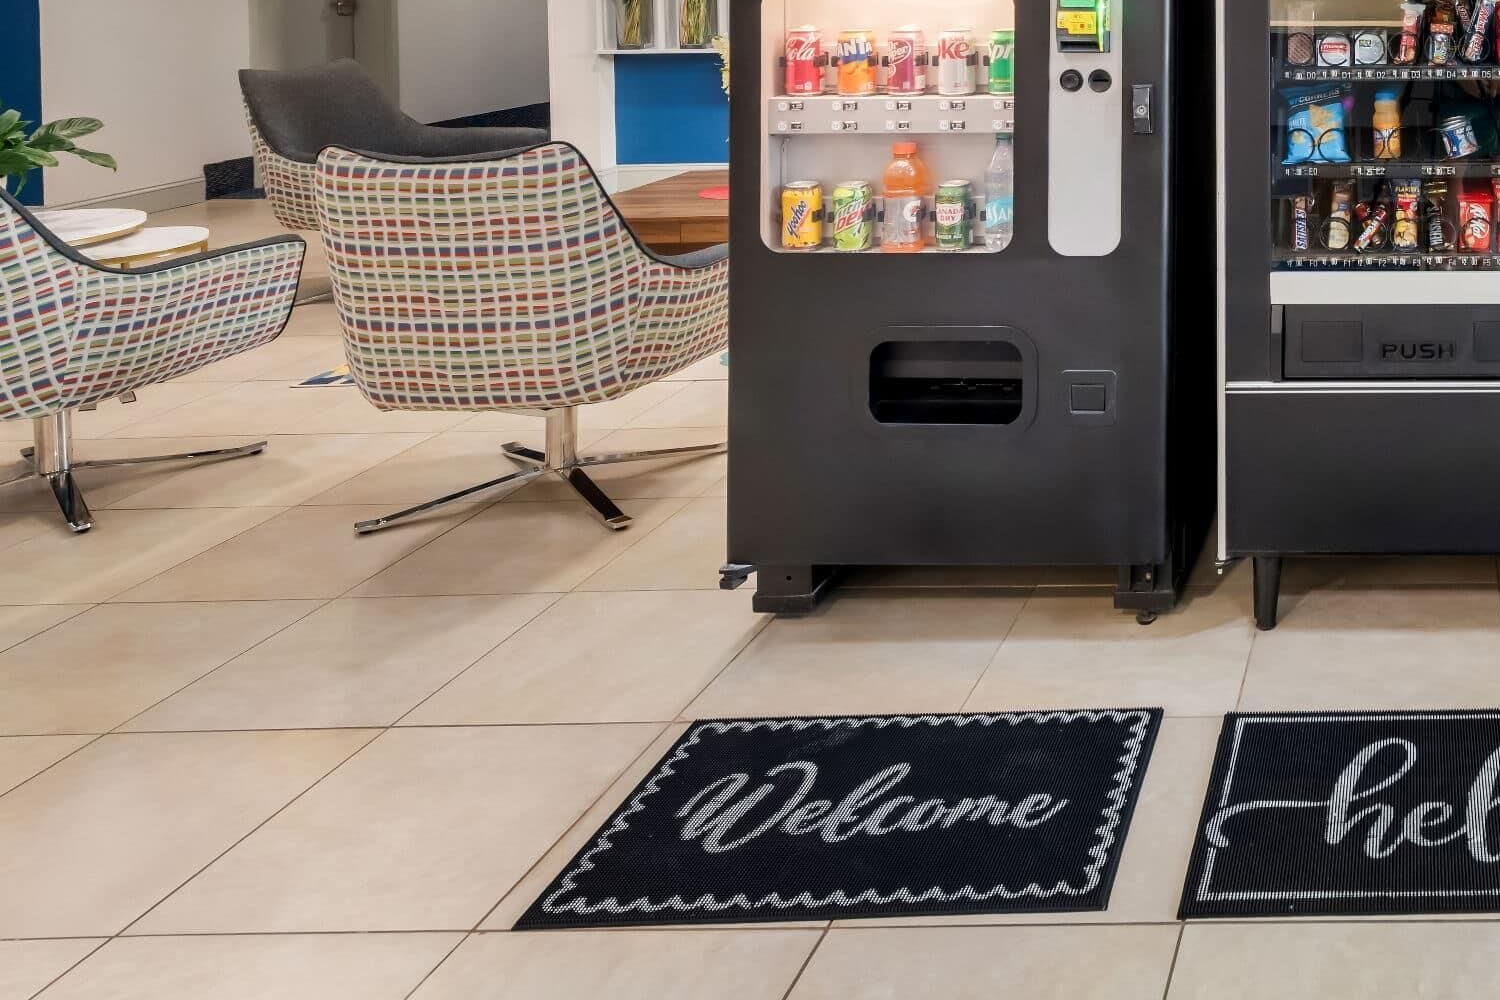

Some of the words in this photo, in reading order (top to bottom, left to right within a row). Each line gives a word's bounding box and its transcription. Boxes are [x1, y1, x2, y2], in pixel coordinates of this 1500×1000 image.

[836, 36, 873, 58] ANTA
[1382, 343, 1455, 359] PUSH
[677, 760, 1071, 854] Welcome
